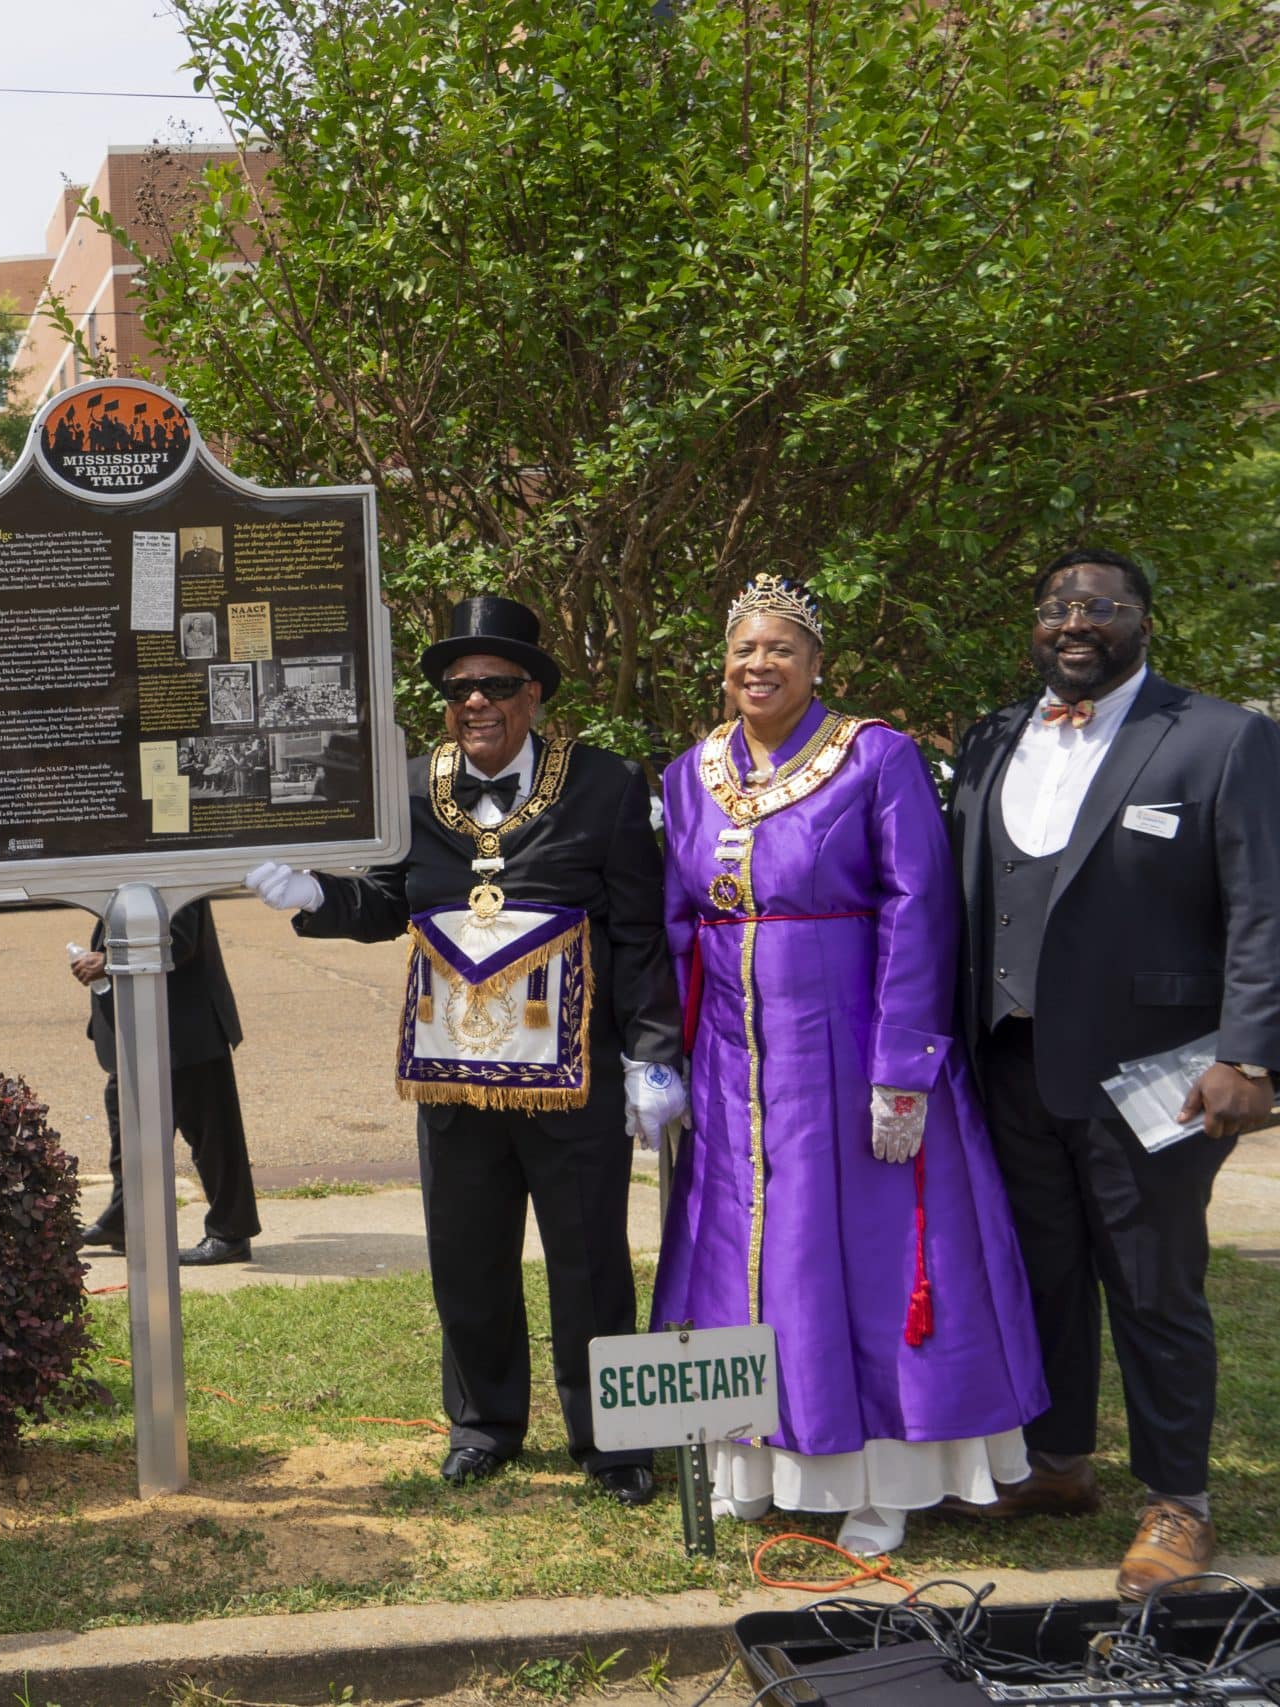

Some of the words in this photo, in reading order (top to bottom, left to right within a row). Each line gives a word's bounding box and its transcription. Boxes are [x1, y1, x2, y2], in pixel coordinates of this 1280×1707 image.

[63, 452, 168, 466] MISSISSIPPI
[75, 464, 158, 476] FREEDOM
[90, 476, 144, 486] TRAIL
[232, 606, 266, 614] NAACP
[599, 1354, 766, 1410] SECRETARY
